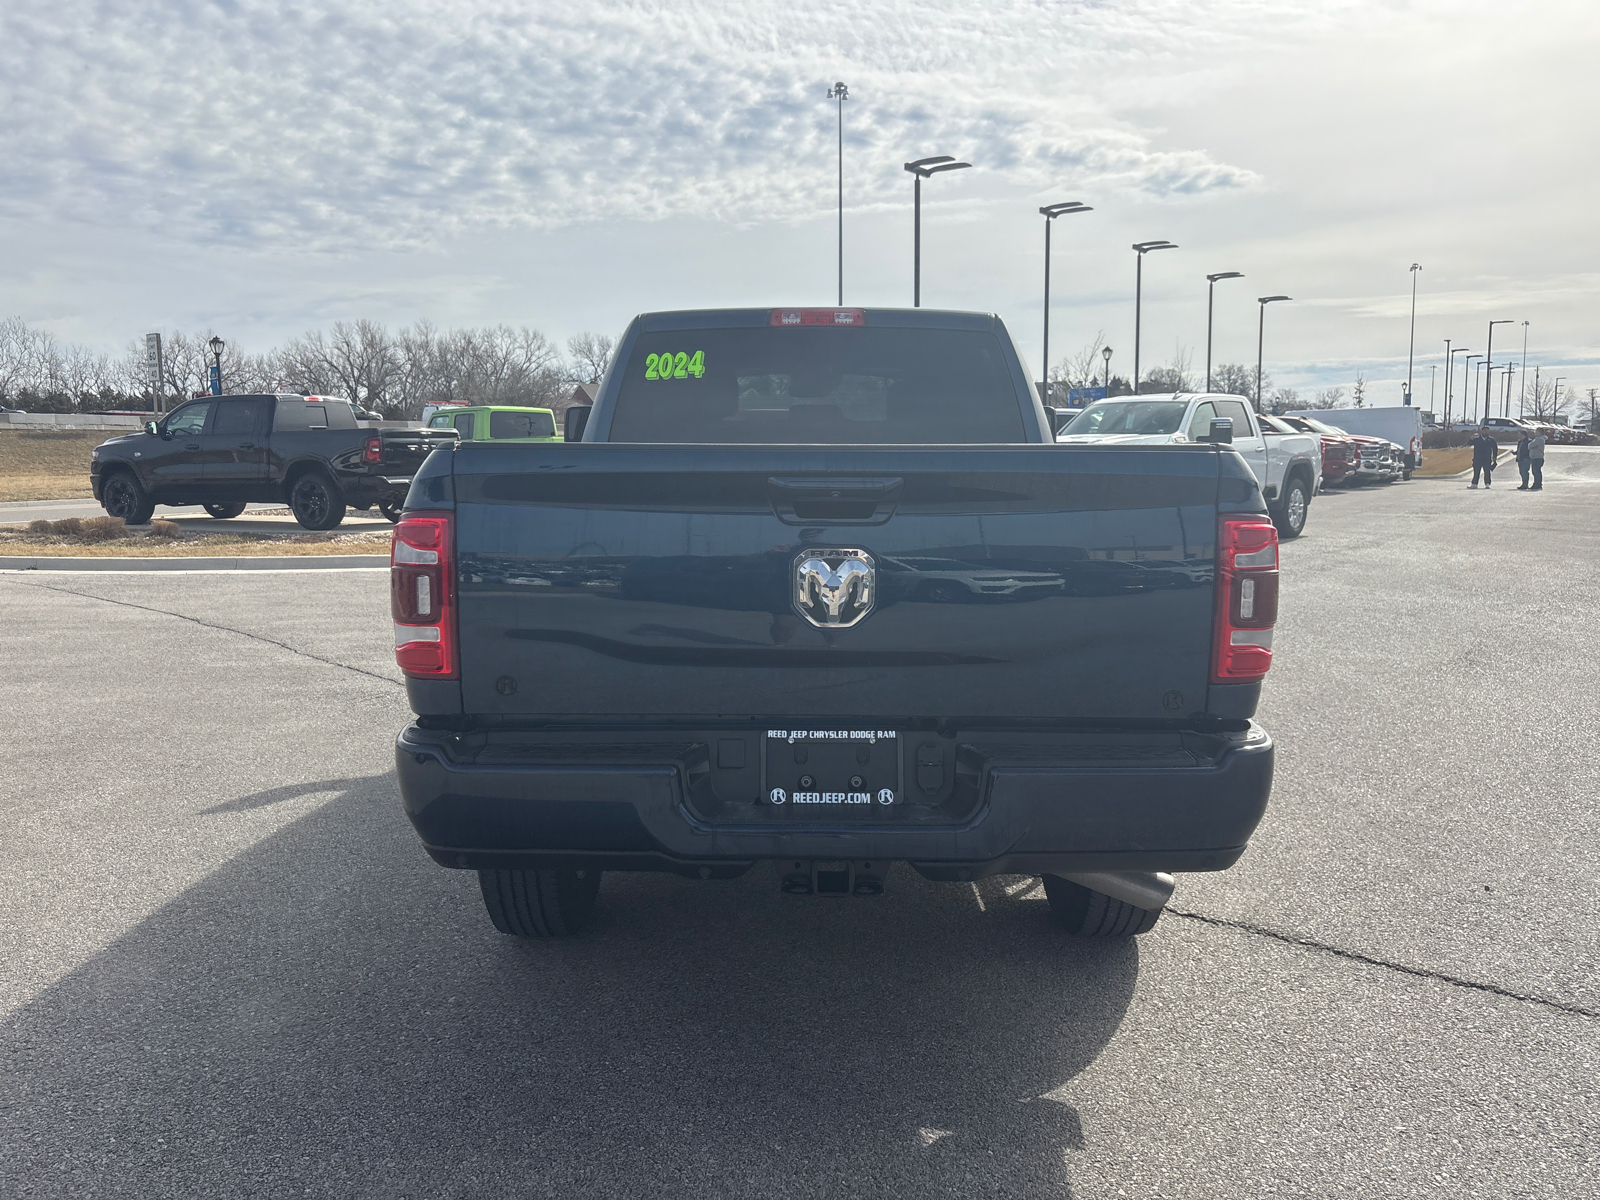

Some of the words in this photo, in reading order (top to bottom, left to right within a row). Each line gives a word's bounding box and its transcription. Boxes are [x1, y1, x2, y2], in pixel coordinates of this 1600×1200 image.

[645, 350, 705, 380] 2024
[767, 730, 787, 738] REED
[789, 730, 808, 739] JEEP
[809, 730, 848, 739] CHRYSLER
[850, 730, 876, 739] DODGE
[877, 730, 896, 739] RAM
[770, 788, 786, 804] R
[793, 792, 871, 804] REEDJEEP.COM
[878, 788, 894, 805] R
